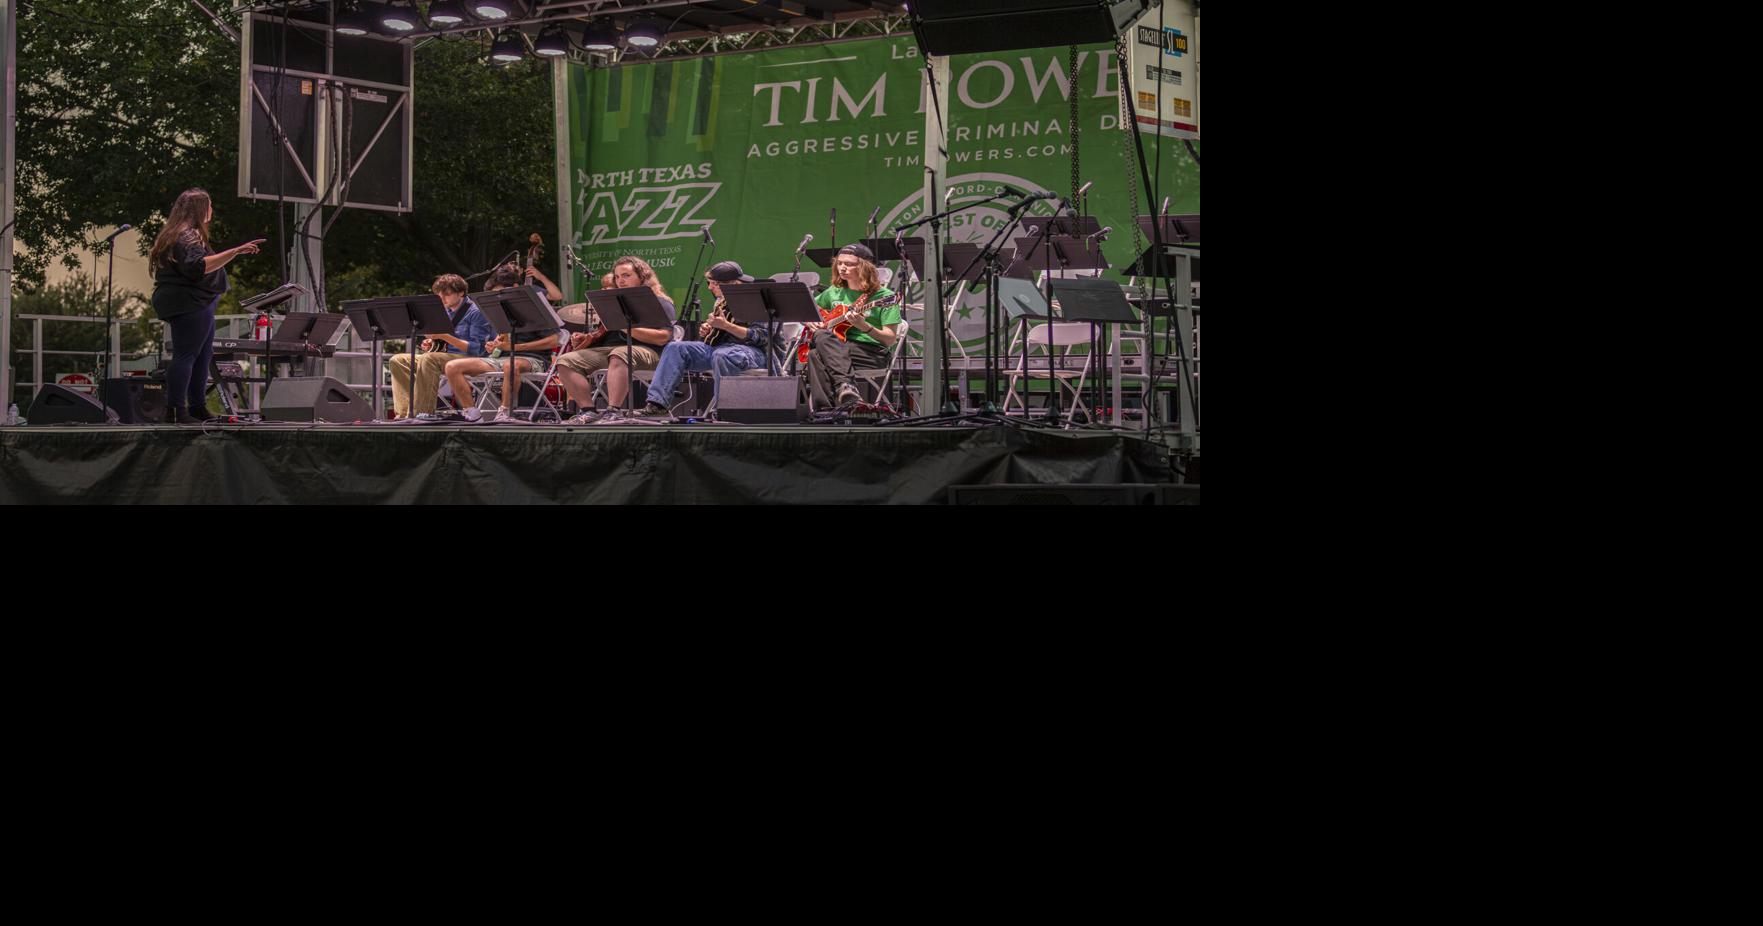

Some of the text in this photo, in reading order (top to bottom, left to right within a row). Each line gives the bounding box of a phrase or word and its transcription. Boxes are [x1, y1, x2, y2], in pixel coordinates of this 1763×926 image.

[1140, 28, 1166, 48] STAGELIE
[1176, 38, 1186, 50] 100
[753, 72, 887, 127] TIM
[747, 131, 919, 158] AGGRESSIVE
[945, 118, 1081, 142] RIMINA
[638, 163, 712, 183] TEXAS
[942, 213, 1007, 231] EST OF
[622, 248, 657, 257] NORTH
[658, 245, 682, 255] TEXAS
